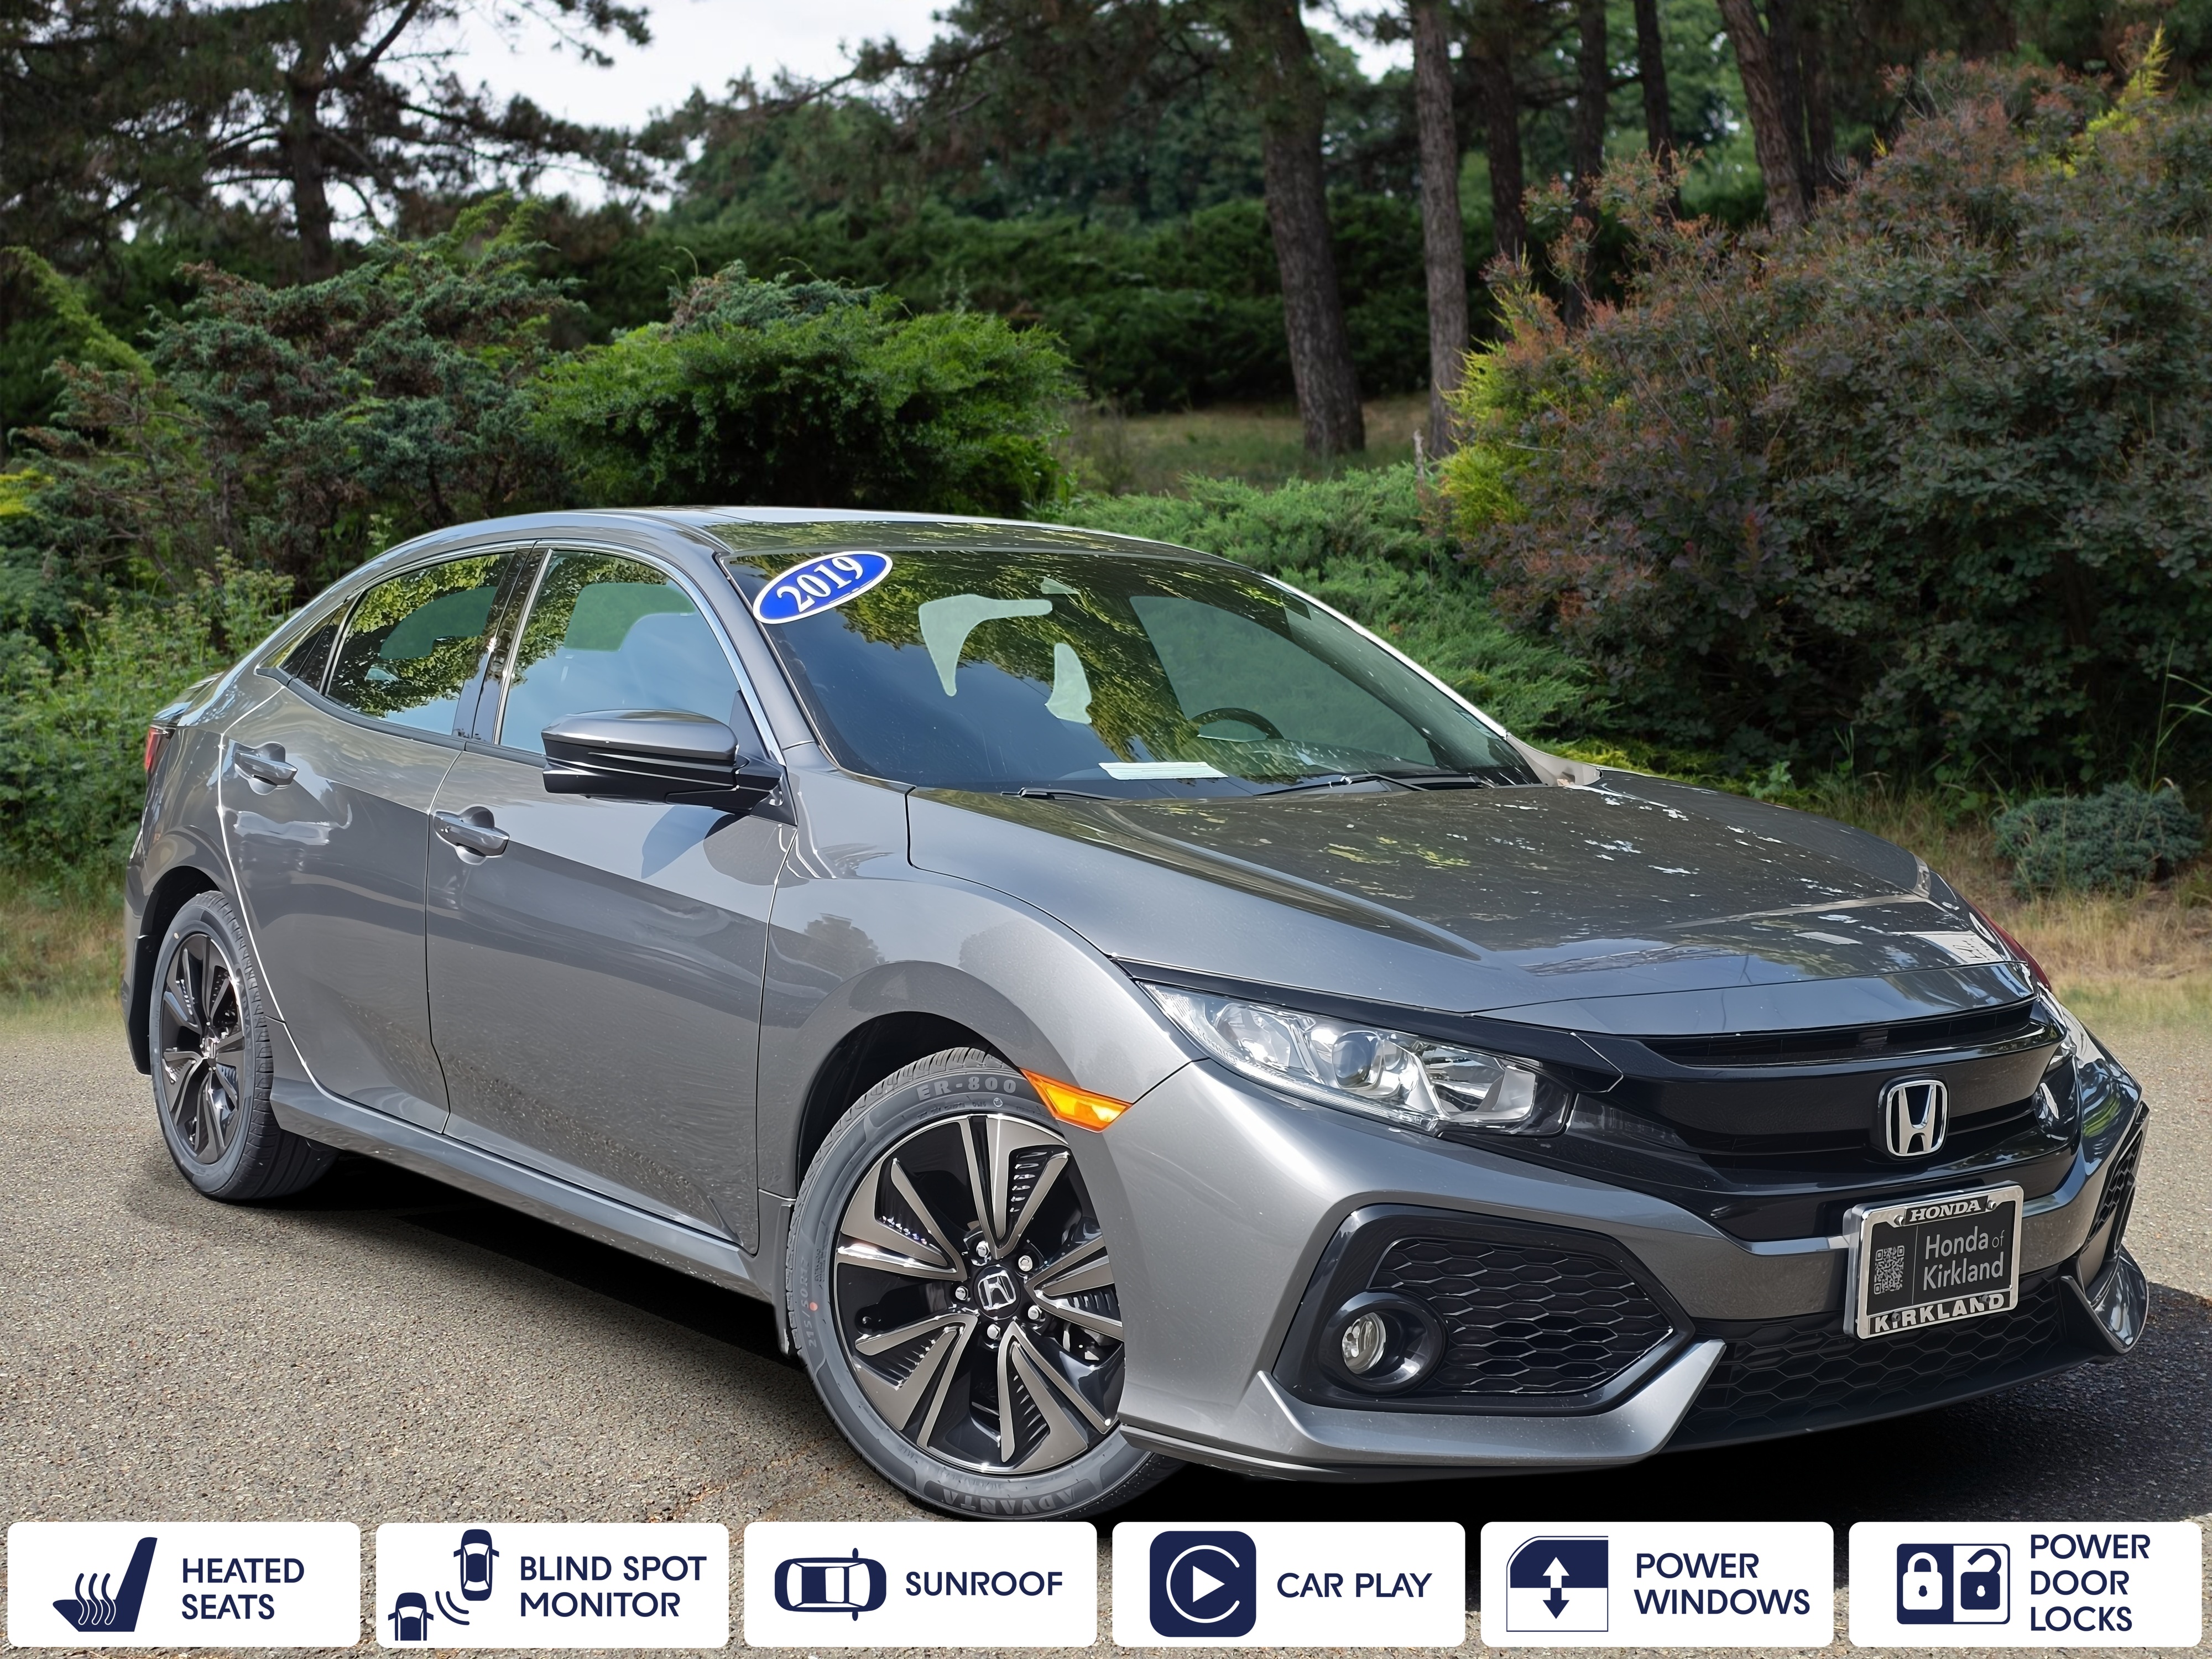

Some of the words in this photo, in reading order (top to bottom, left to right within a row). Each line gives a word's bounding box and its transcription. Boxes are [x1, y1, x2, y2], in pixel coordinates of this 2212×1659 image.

[776, 556, 863, 612] 2019
[916, 1076, 1016, 1101] ER-800
[1909, 1199, 1981, 1222] HONDA
[1925, 1225, 1989, 1260] Honda
[1991, 1229, 2005, 1248] of
[1923, 1251, 2004, 1291] Kirkland
[943, 1488, 1074, 1515] ADVANTA
